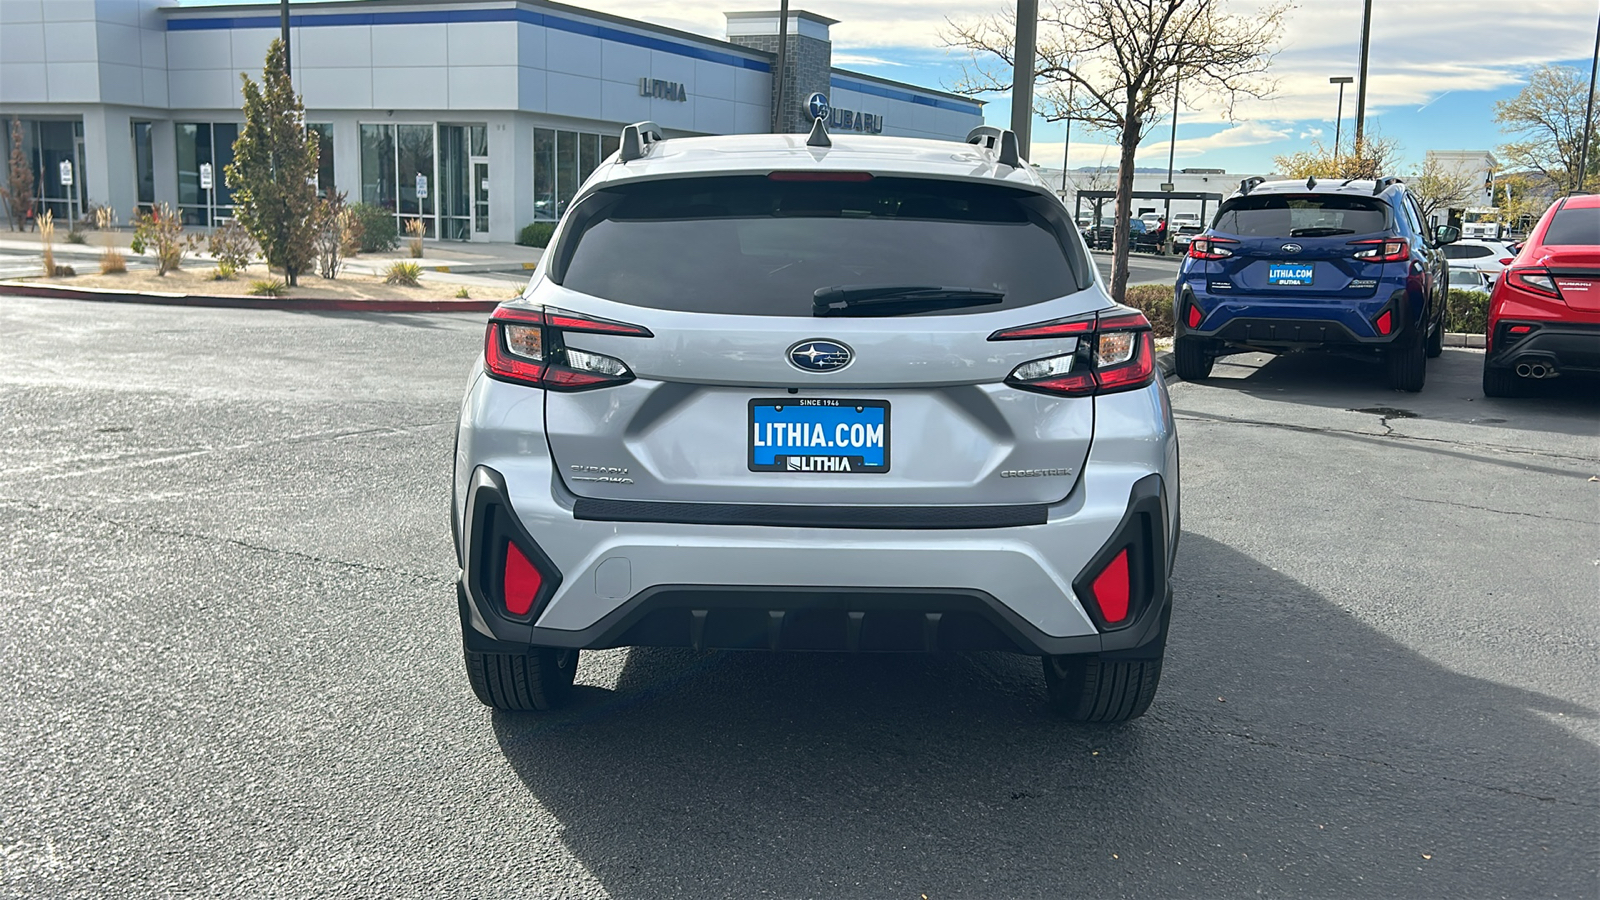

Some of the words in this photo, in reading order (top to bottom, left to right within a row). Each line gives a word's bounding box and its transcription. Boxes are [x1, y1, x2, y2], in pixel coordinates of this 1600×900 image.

[640, 77, 687, 102] LITHIA
[1270, 269, 1313, 278] LITHIA.COM
[754, 422, 884, 448] LITHIA.COM
[570, 464, 629, 475] SUBARU
[801, 456, 851, 471] LITHIA
[1000, 467, 1073, 478] CROSSTREK
